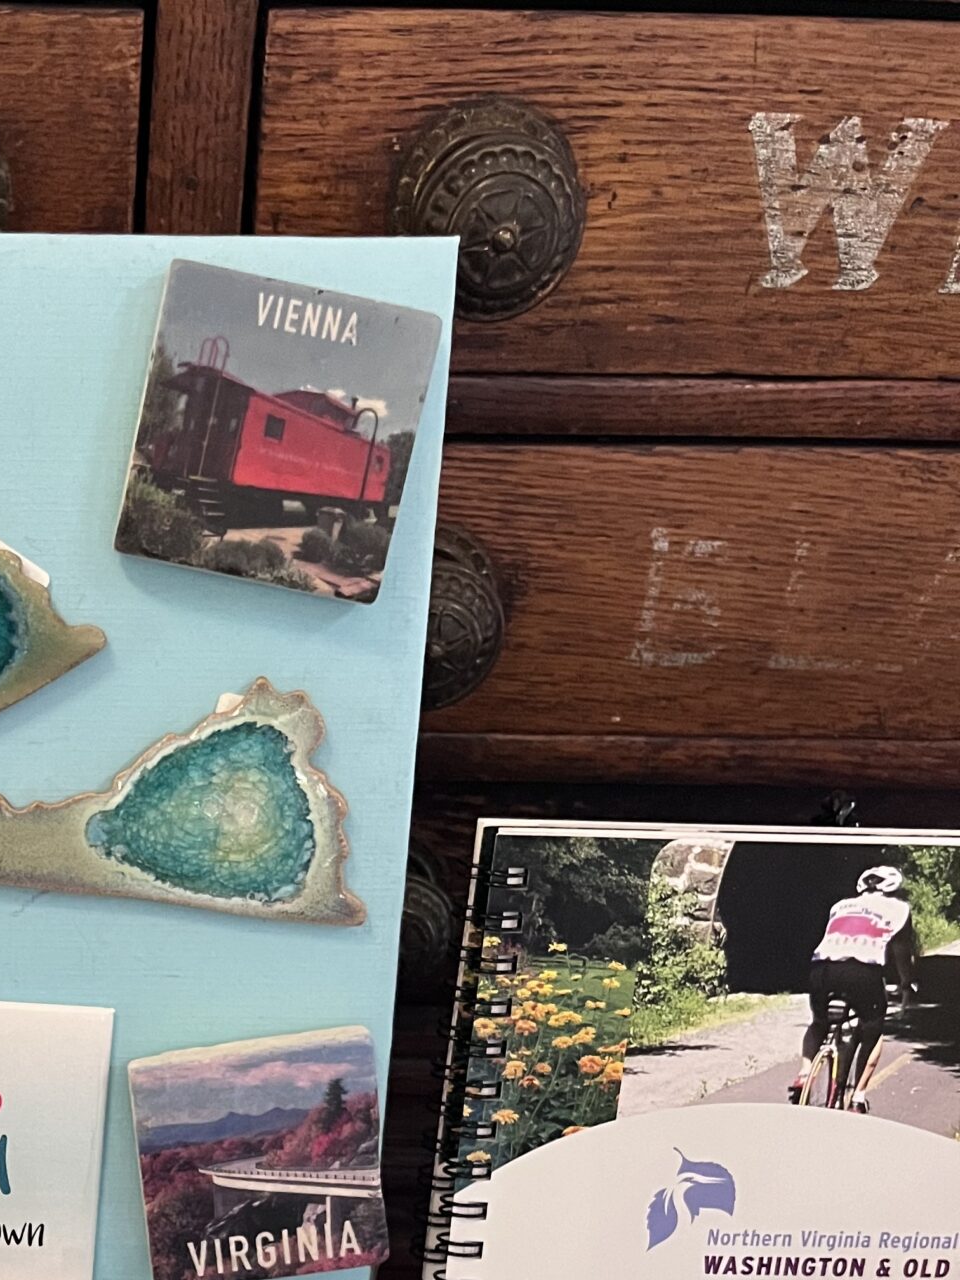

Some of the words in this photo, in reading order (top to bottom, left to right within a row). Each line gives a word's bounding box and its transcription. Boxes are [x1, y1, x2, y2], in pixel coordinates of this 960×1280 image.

[747, 110, 960, 296] W
[257, 291, 359, 347] VIENNA
[186, 1219, 362, 1278] VIRGINIA
[703, 1255, 866, 1278] WASHINGTON
[875, 1258, 891, 1278] &
[903, 1258, 951, 1279] OLD
[707, 1228, 792, 1247] Northern
[801, 1230, 872, 1252] Virginia
[878, 1231, 960, 1253] Regional
